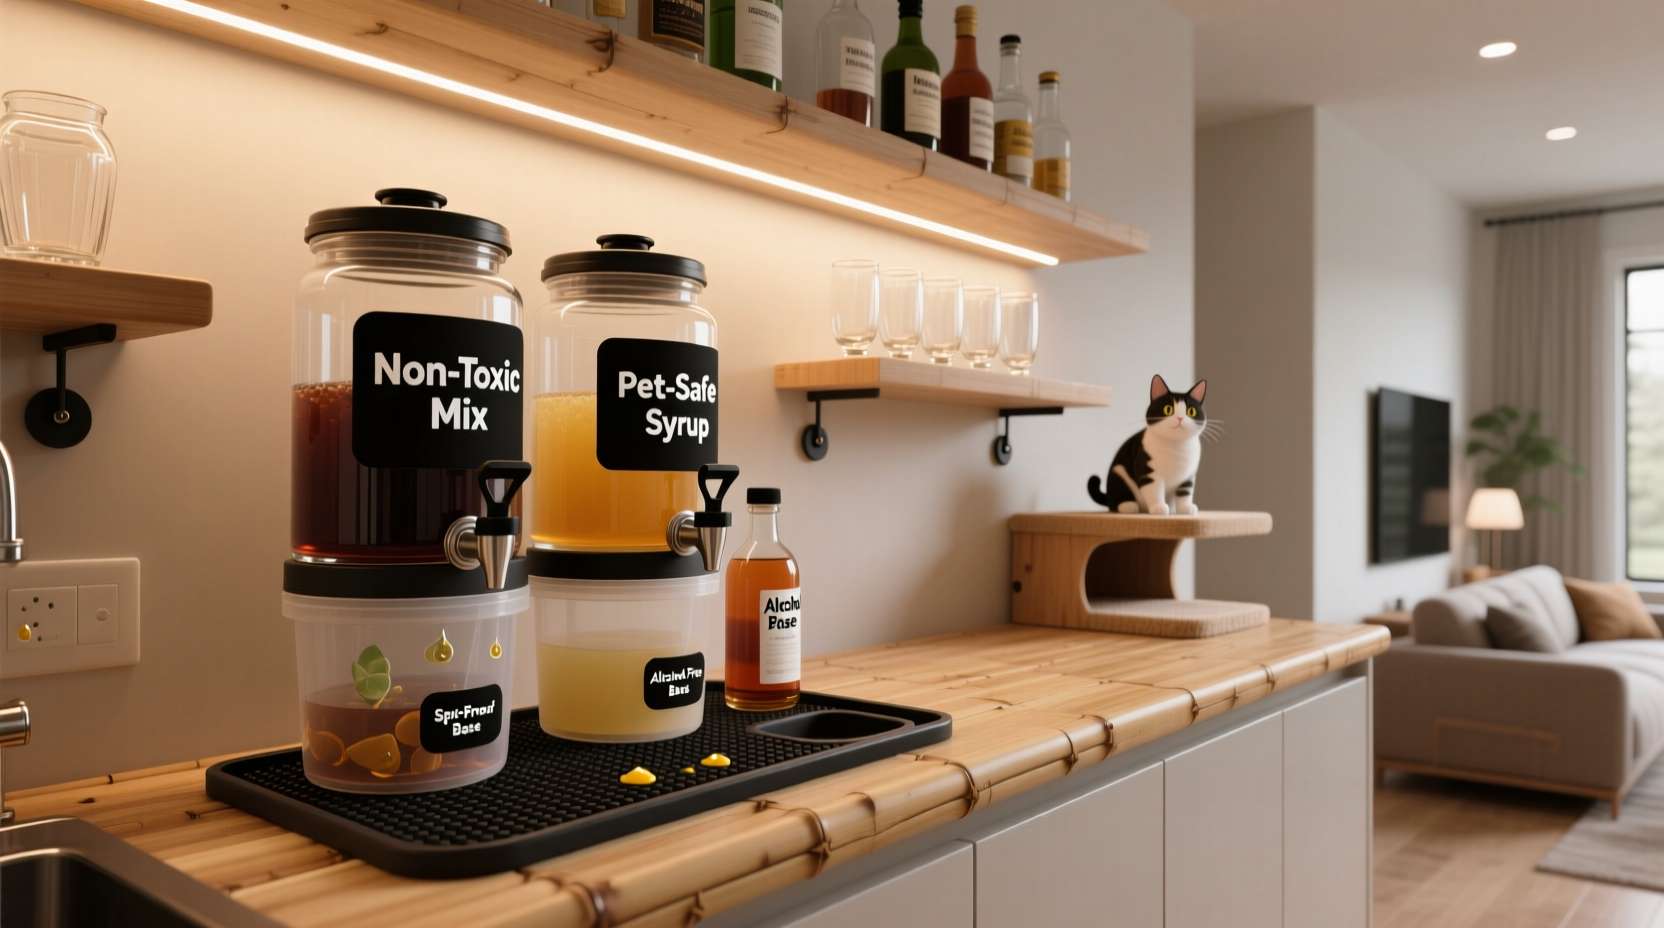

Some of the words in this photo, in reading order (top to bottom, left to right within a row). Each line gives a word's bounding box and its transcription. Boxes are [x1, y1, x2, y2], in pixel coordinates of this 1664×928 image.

[374, 352, 520, 393] Non-Toxic
[618, 370, 717, 403] Pet-Safe
[431, 397, 489, 431] Mix
[645, 408, 710, 444] Syrup
